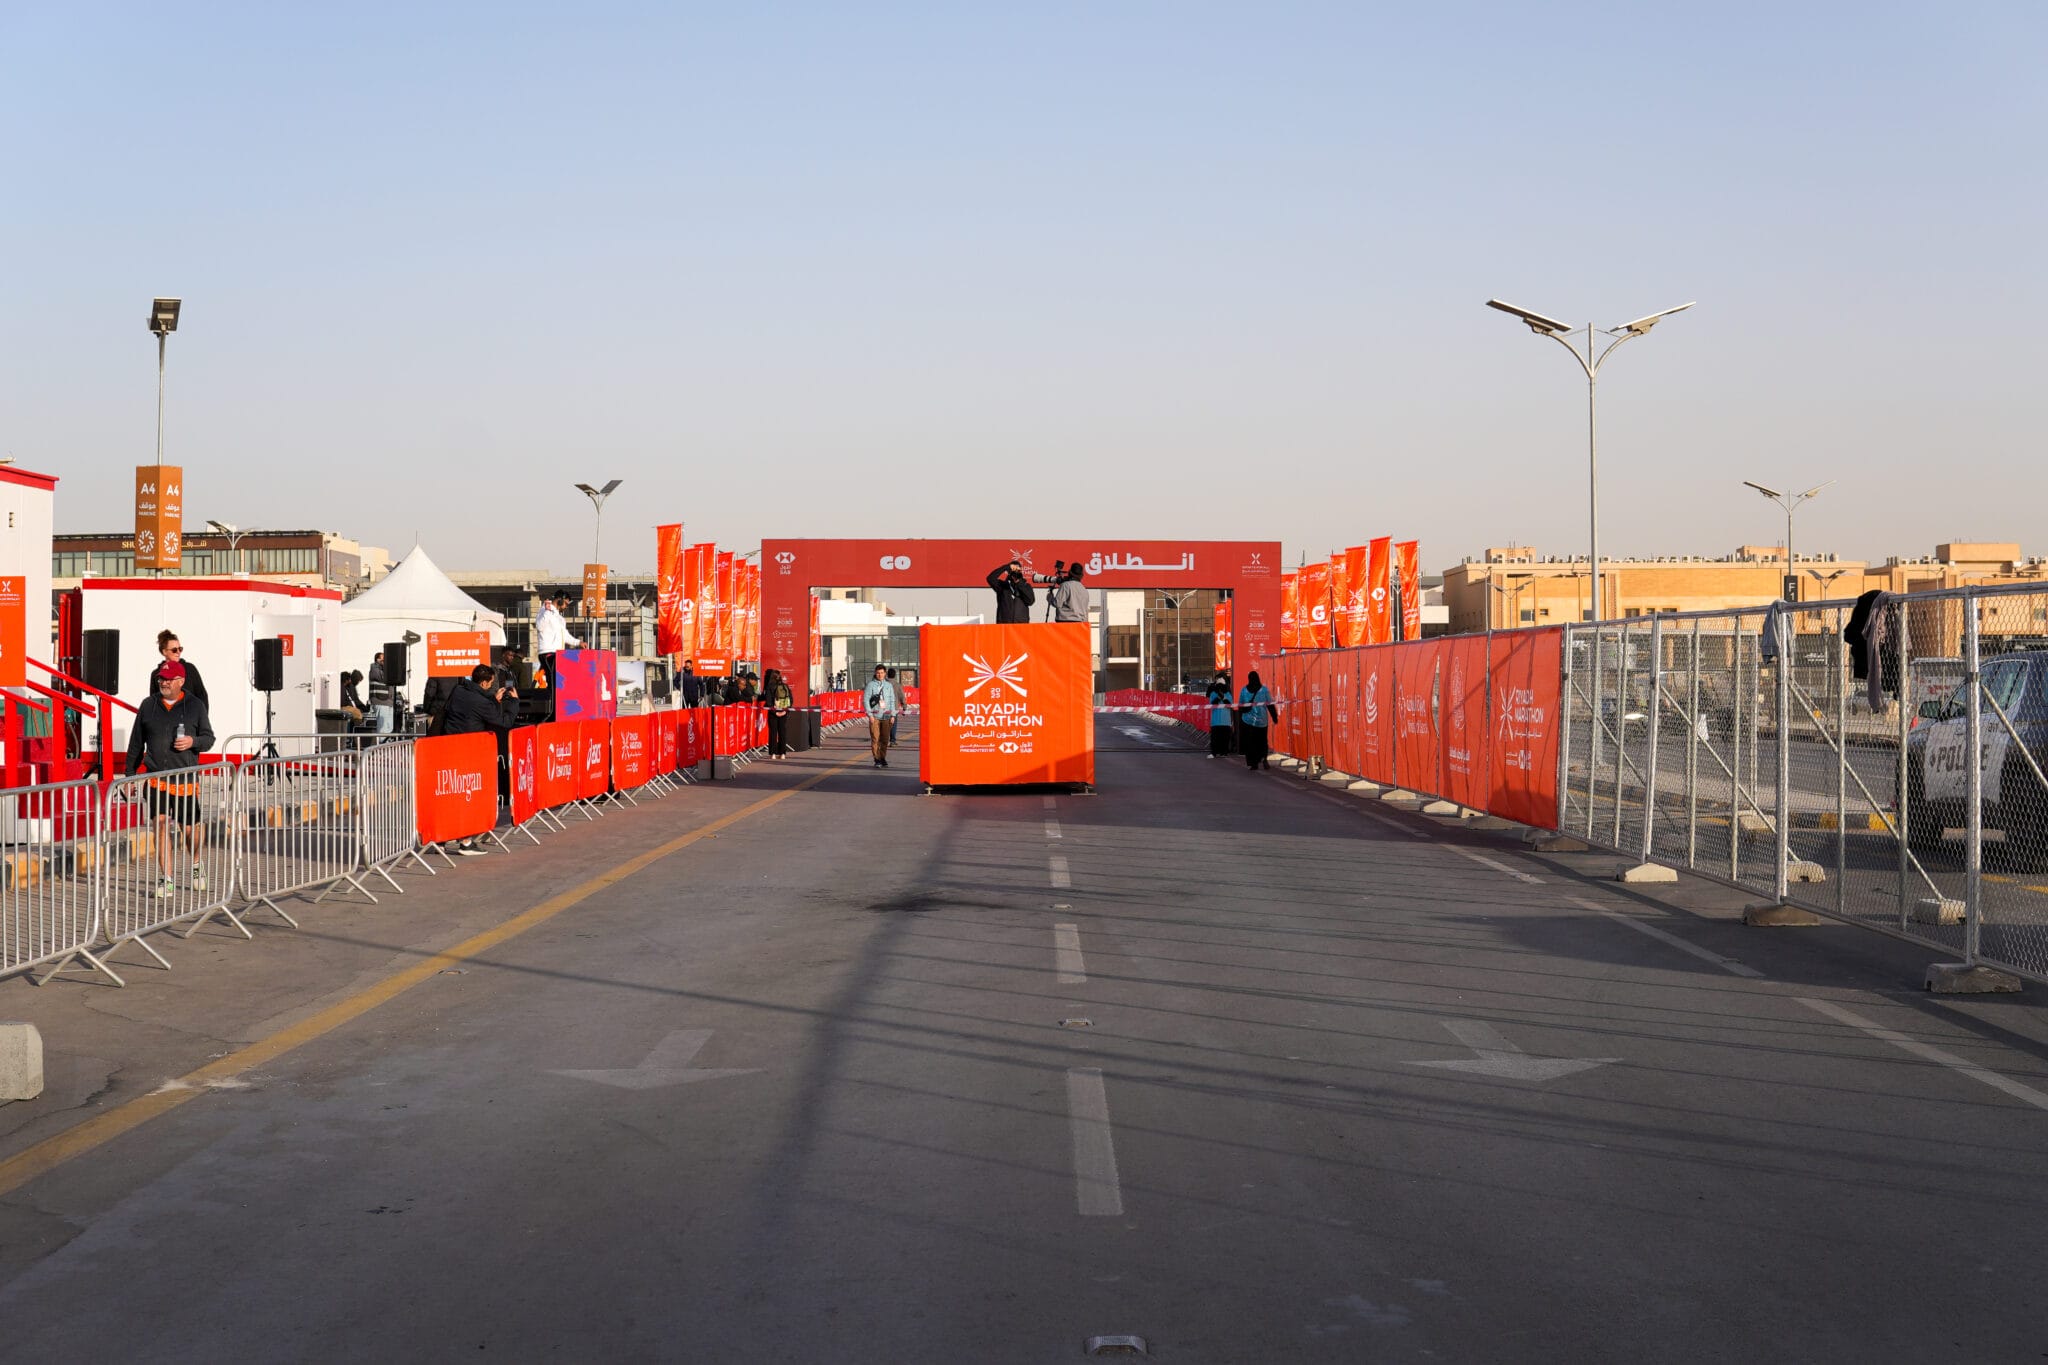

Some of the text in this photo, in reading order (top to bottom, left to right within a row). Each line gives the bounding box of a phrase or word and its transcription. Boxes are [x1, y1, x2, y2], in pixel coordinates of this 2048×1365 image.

[141, 482, 156, 495] A4
[166, 484, 180, 496] A4
[879, 555, 912, 570] GO
[1084, 552, 1195, 576] انطلاق
[444, 658, 481, 666] WAVES
[1515, 689, 1534, 705] RIYADH
[964, 702, 1027, 715] RIYADH
[1514, 707, 1544, 724] MARATHON
[949, 715, 1043, 727] MARATHON
[960, 730, 1033, 739] ماراثون الرياض
[1937, 743, 1990, 773] POLE
[435, 769, 482, 802] J.P.Morgan
